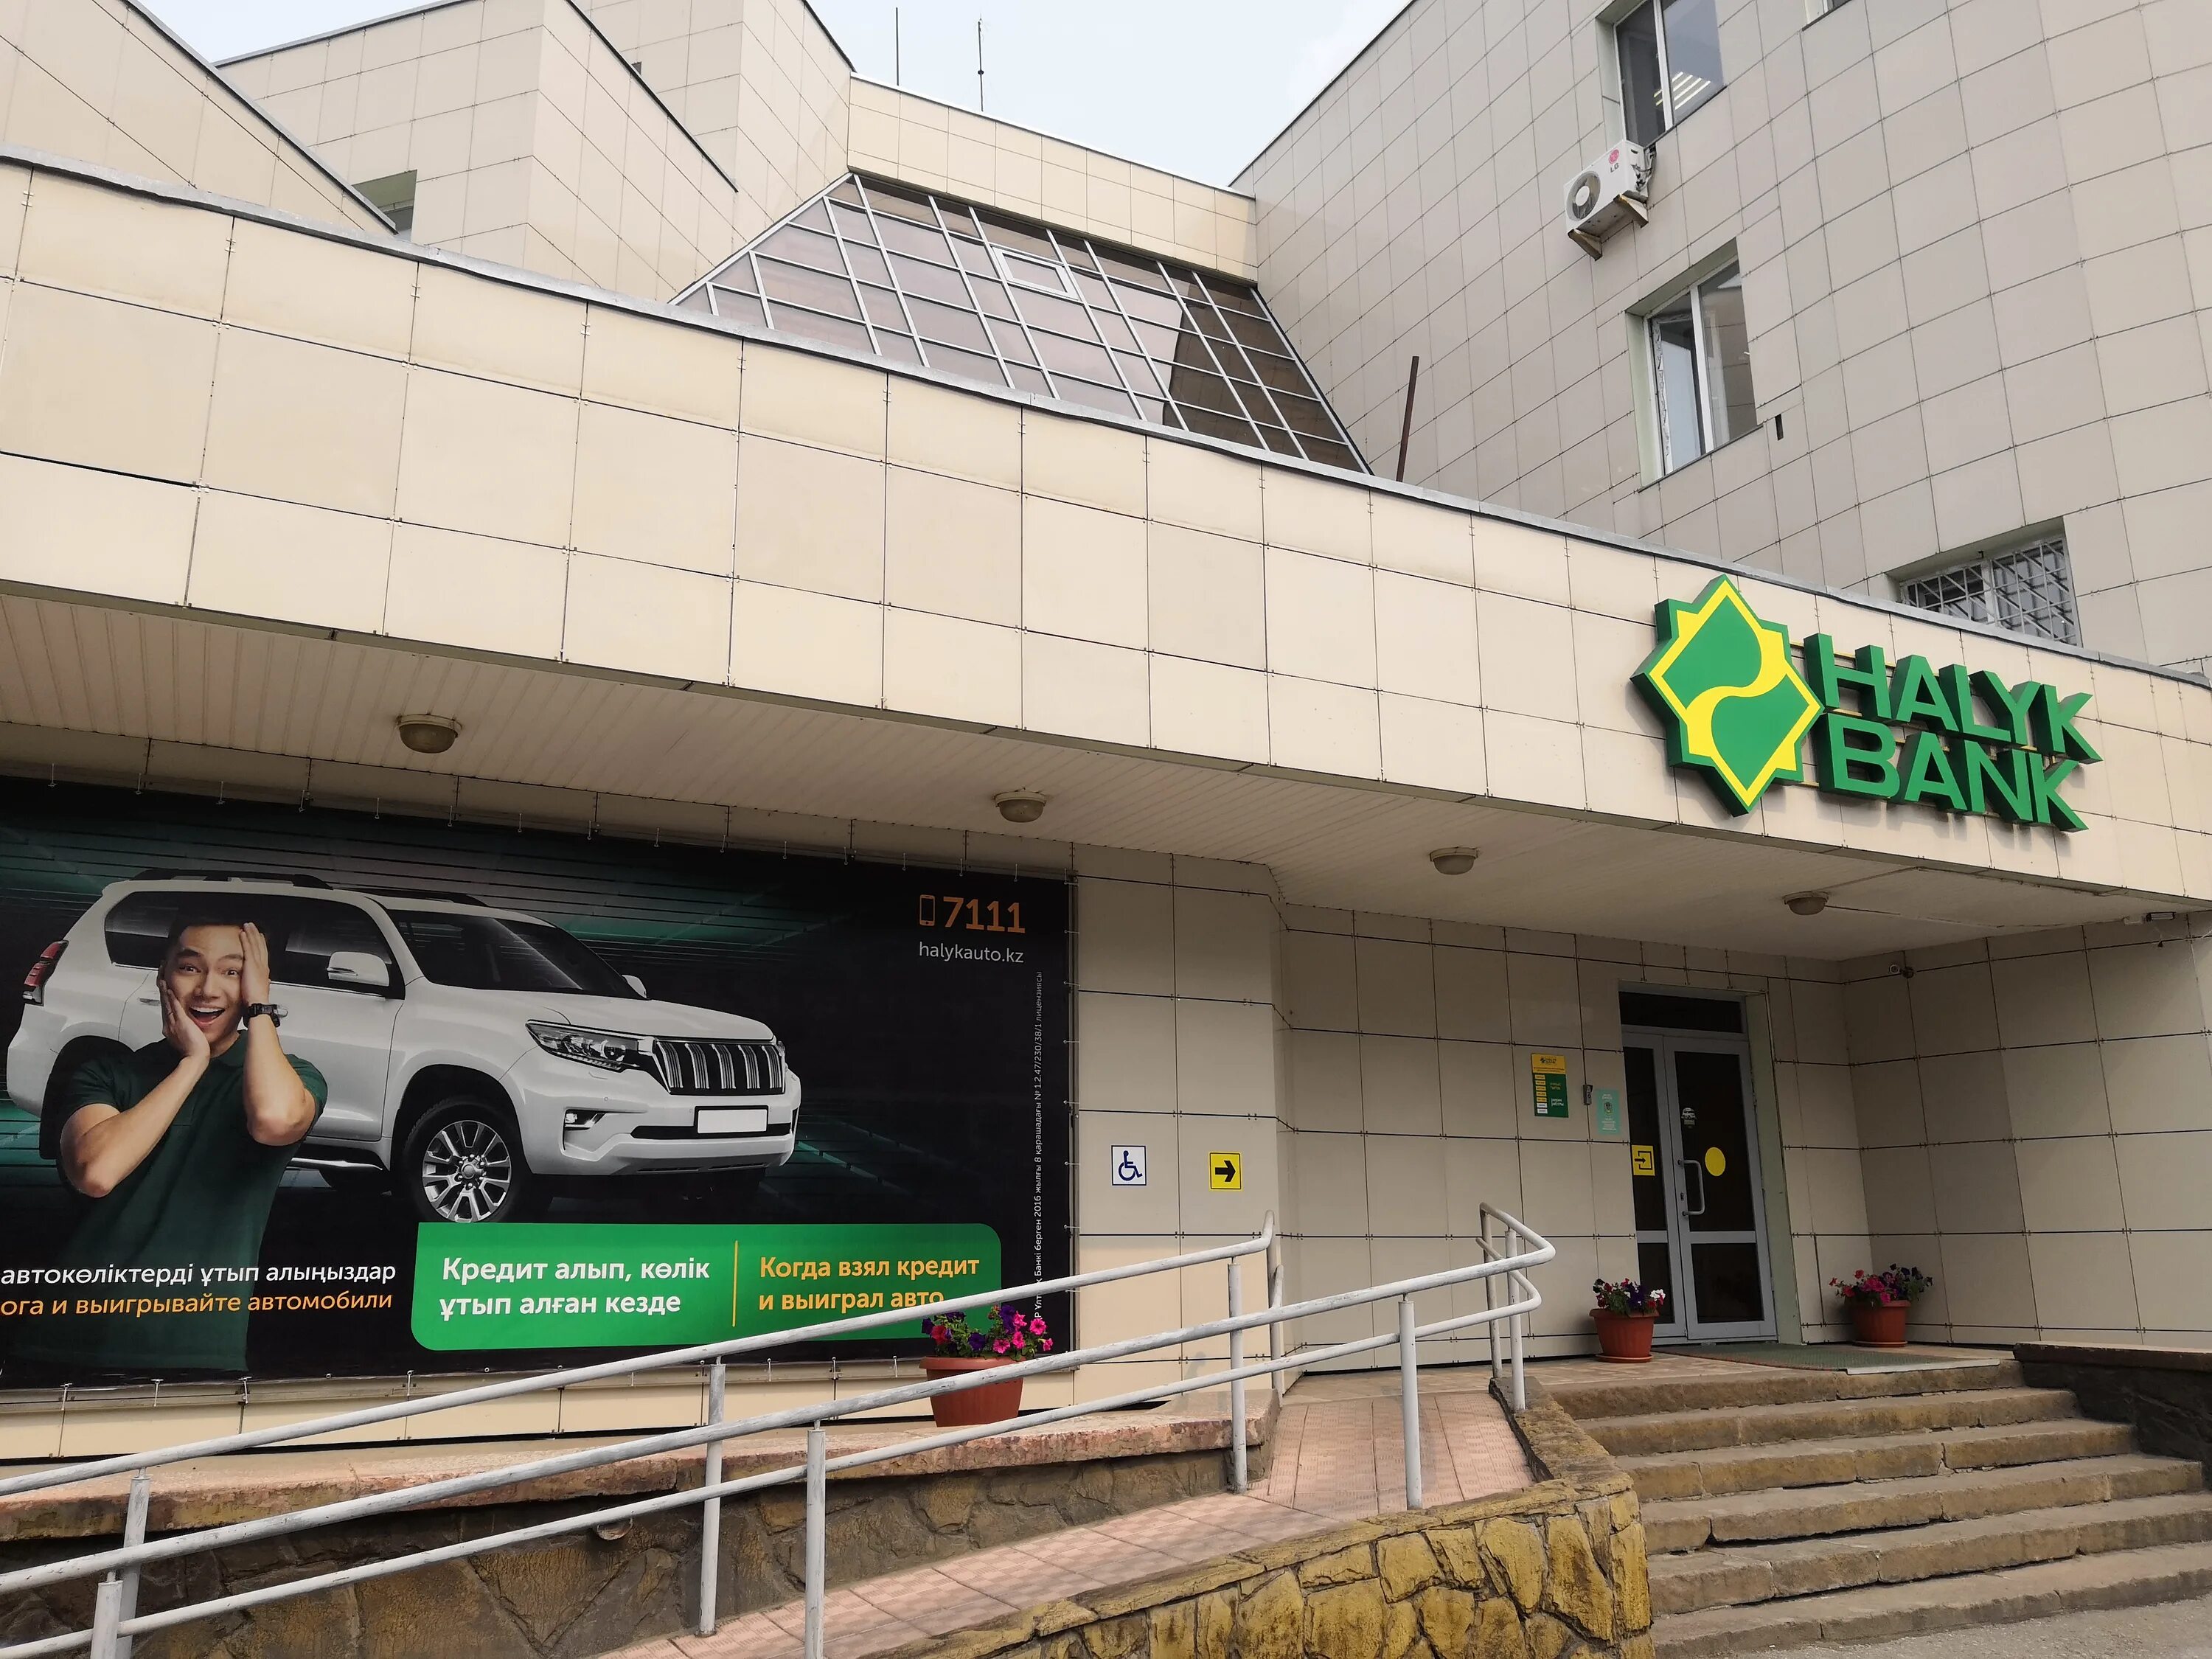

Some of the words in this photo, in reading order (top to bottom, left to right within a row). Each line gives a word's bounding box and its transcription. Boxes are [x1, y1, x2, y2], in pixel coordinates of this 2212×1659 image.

[1610, 162, 1620, 173] LG
[1803, 633, 2103, 765] HALYK
[1818, 713, 2089, 832] BANK
[942, 896, 1026, 933] 7111
[919, 941, 1025, 963] halykauto.kz
[1035, 970, 1043, 1021] лицензиясы
[1034, 1023, 1043, 1088] 1.2.47/230/38/1
[1034, 1090, 1042, 1100] №
[1034, 1102, 1043, 1154] қарашадағы
[1034, 1164, 1043, 1193] жылғы
[1034, 1194, 1043, 1217] 2016
[1034, 1218, 1043, 1250] берген
[1, 1263, 194, 1286] автокөліктерді
[201, 1265, 260, 1287] ұтып
[265, 1264, 397, 1284] алыңыздар
[442, 1257, 548, 1285] Кредит
[554, 1262, 633, 1282] алып,
[641, 1257, 710, 1279] көлік
[760, 1256, 832, 1281] Когда
[838, 1260, 890, 1277] взял
[897, 1259, 980, 1281] кредит
[1034, 1252, 1043, 1276] Банкі
[1, 1300, 44, 1316] ога
[52, 1300, 68, 1315] и
[76, 1293, 241, 1318] выигрывайте
[247, 1290, 392, 1312] автомобили
[439, 1297, 511, 1321] ұтып
[519, 1296, 597, 1314] алған
[605, 1295, 681, 1316] кезде
[759, 1294, 773, 1310] и
[781, 1292, 884, 1314] выиграл
[890, 1291, 945, 1308] авто
[1034, 1278, 1043, 1310] Ұлтқ
